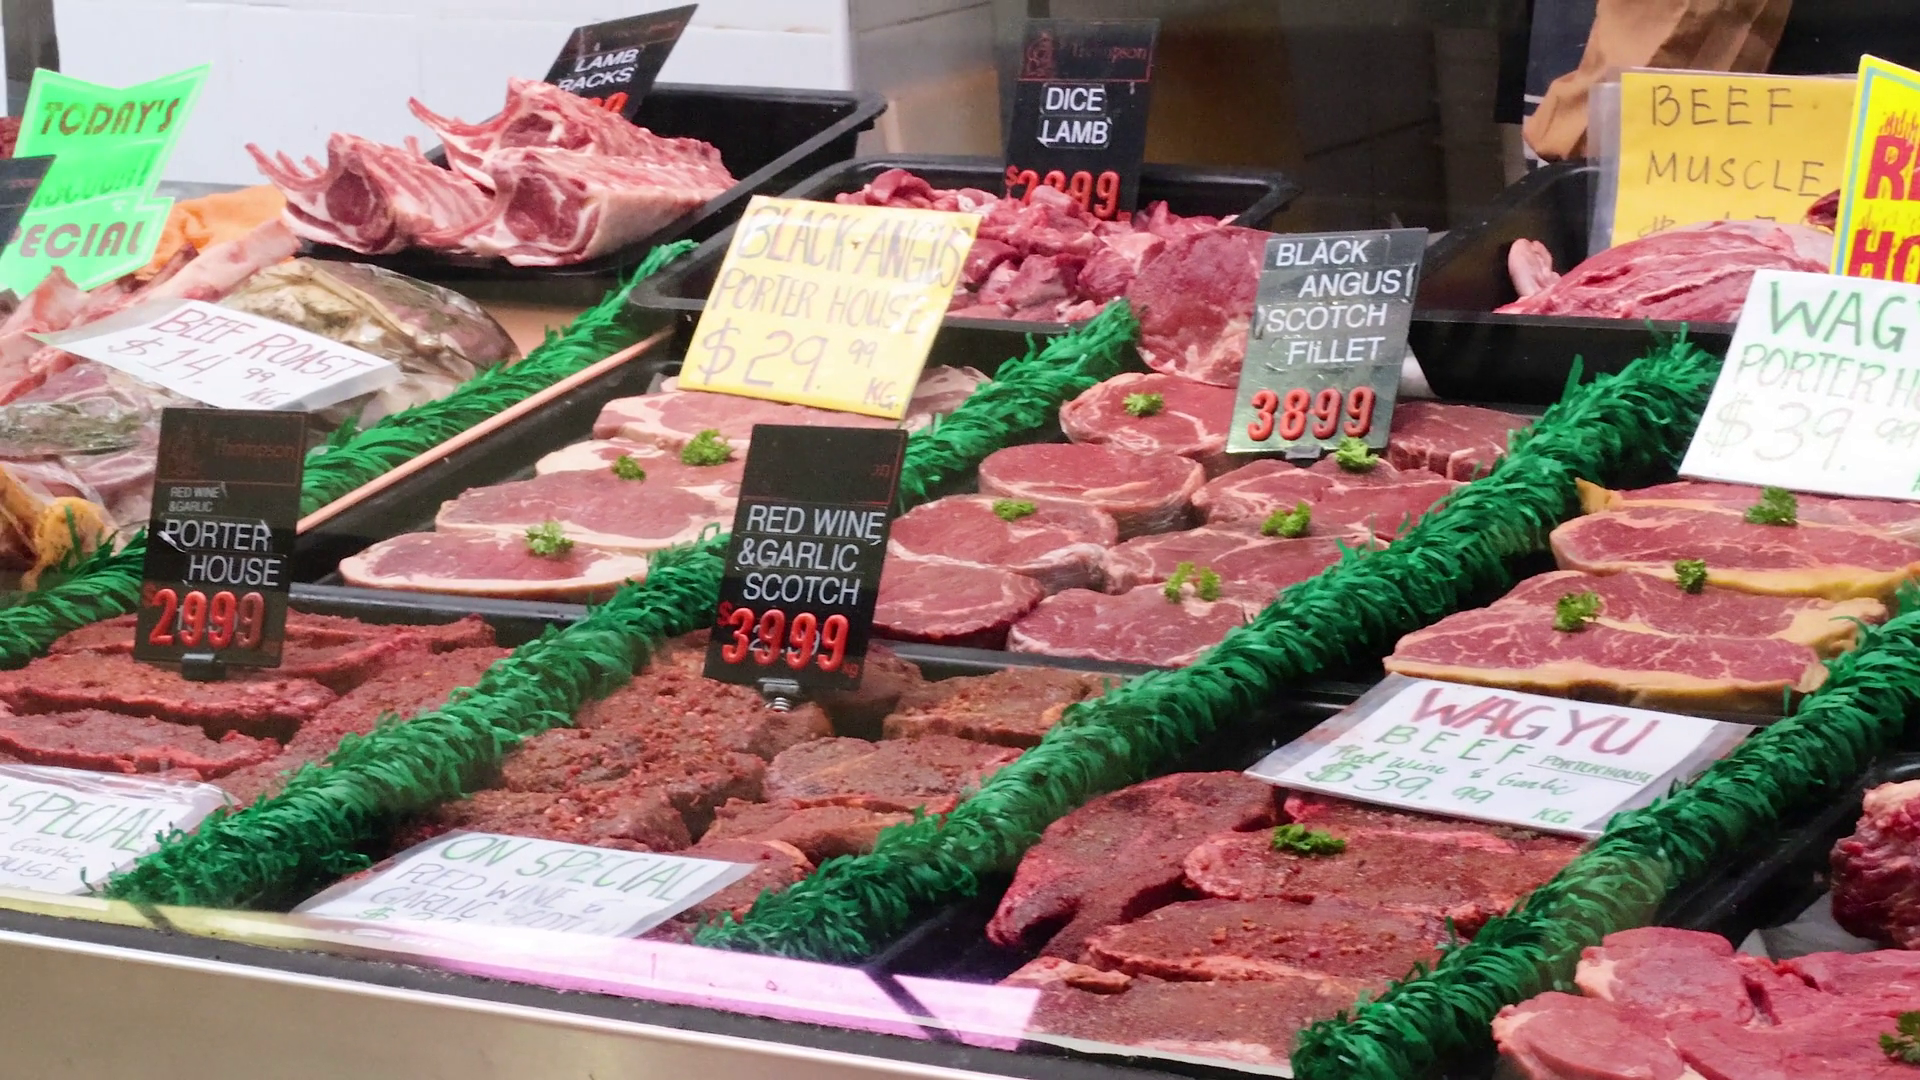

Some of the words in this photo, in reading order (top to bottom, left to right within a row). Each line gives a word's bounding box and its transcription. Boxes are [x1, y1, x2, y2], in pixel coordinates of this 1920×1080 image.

[574, 49, 639, 73] LAMB
[558, 67, 635, 91] RACKS
[41, 97, 181, 136] TODAY'S
[1045, 87, 1105, 111] DICE
[1652, 84, 1794, 127] BEEF
[1039, 120, 1109, 144] LAMB
[1645, 150, 1825, 197] MUSCLE
[737, 205, 860, 272] BLACK
[1276, 239, 1371, 267] BLACK
[710, 268, 819, 319] PORTER
[1298, 269, 1402, 298] ANGUS
[826, 285, 926, 335] HOUSE
[1266, 303, 1388, 332] SCOTCH
[1770, 281, 1920, 352] WAG
[150, 308, 257, 344] BEEF
[235, 333, 374, 380] ROAST
[1287, 336, 1386, 365] FILLET
[1734, 343, 1886, 404] PORTER
[1247, 386, 1376, 441] 3899
[168, 501, 213, 512] &GARLIC
[170, 486, 191, 498] RED
[194, 486, 220, 498] WINE
[163, 518, 271, 551] PORTER
[746, 504, 804, 534] RED
[815, 508, 886, 539] WINE
[188, 555, 281, 587] HOUSE
[737, 537, 859, 573] &GARLIC
[743, 572, 860, 606] SCOTCH
[1411, 687, 1660, 755] WAGYU
[1374, 725, 1535, 765] BEEF
[1330, 744, 1389, 764] Red
[1387, 756, 1448, 775] Wine
[1497, 772, 1579, 795] Garlic
[0, 790, 165, 853] SPECIAL
[1531, 807, 1574, 824] KG
[10, 838, 85, 863] Garlic
[396, 862, 487, 890] RED
[485, 880, 578, 908] WINE
[440, 836, 532, 867] ON
[516, 848, 708, 901] SPECIAL
[370, 887, 498, 919] GARLIC
